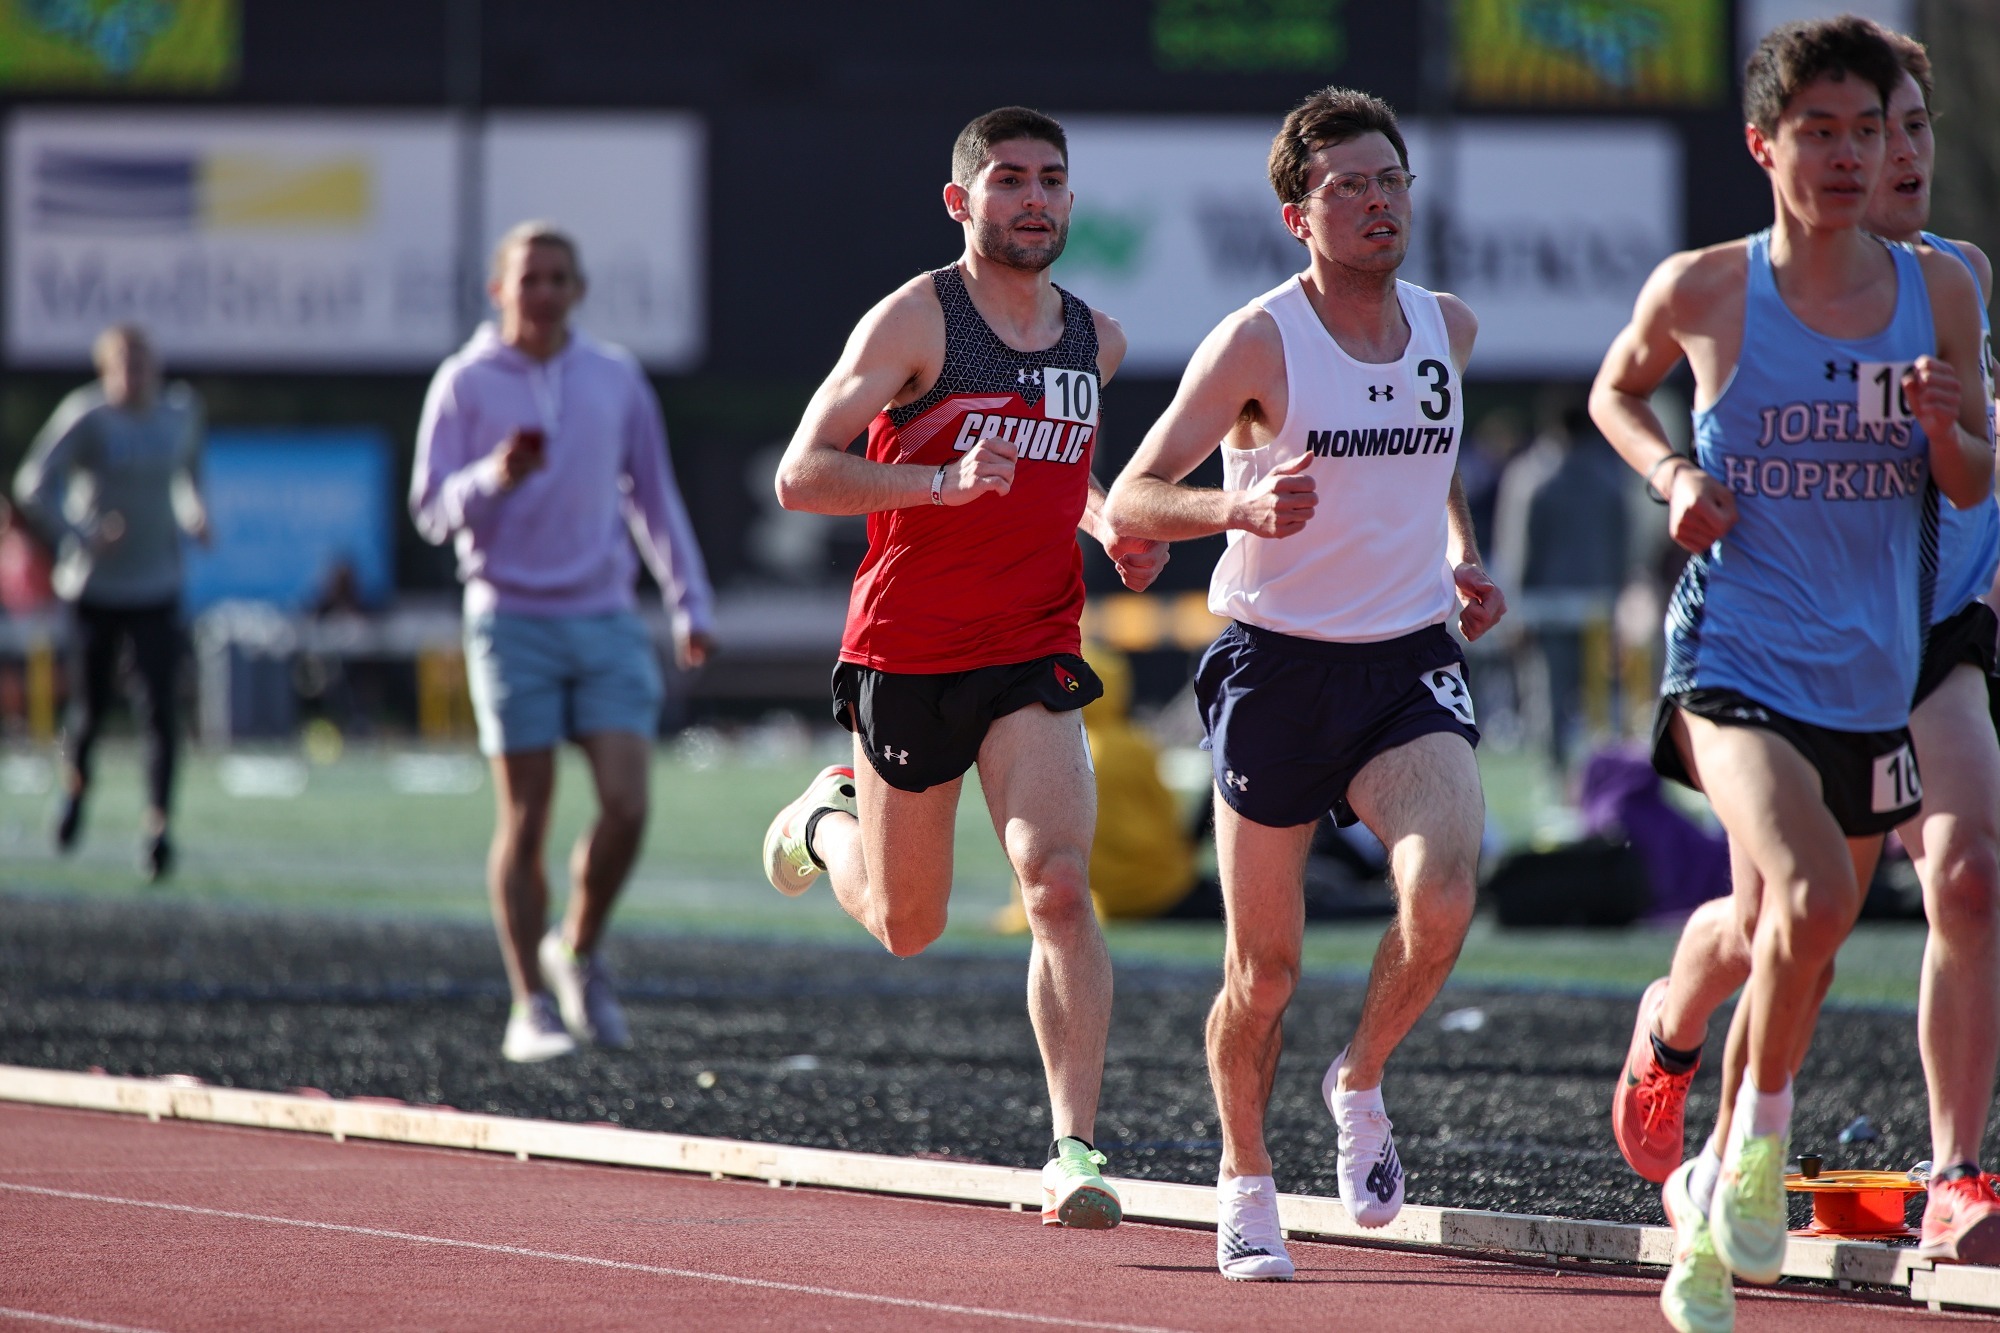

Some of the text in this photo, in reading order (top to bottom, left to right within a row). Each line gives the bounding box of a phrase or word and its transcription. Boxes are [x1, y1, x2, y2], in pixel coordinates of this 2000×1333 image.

[1055, 372, 1092, 421] 10
[1417, 359, 1451, 421] 3
[1306, 427, 1454, 458] MONMOUTH
[1758, 402, 1915, 448] JOHNS
[1724, 456, 1924, 500] HOPKINS
[1432, 671, 1471, 720] 3
